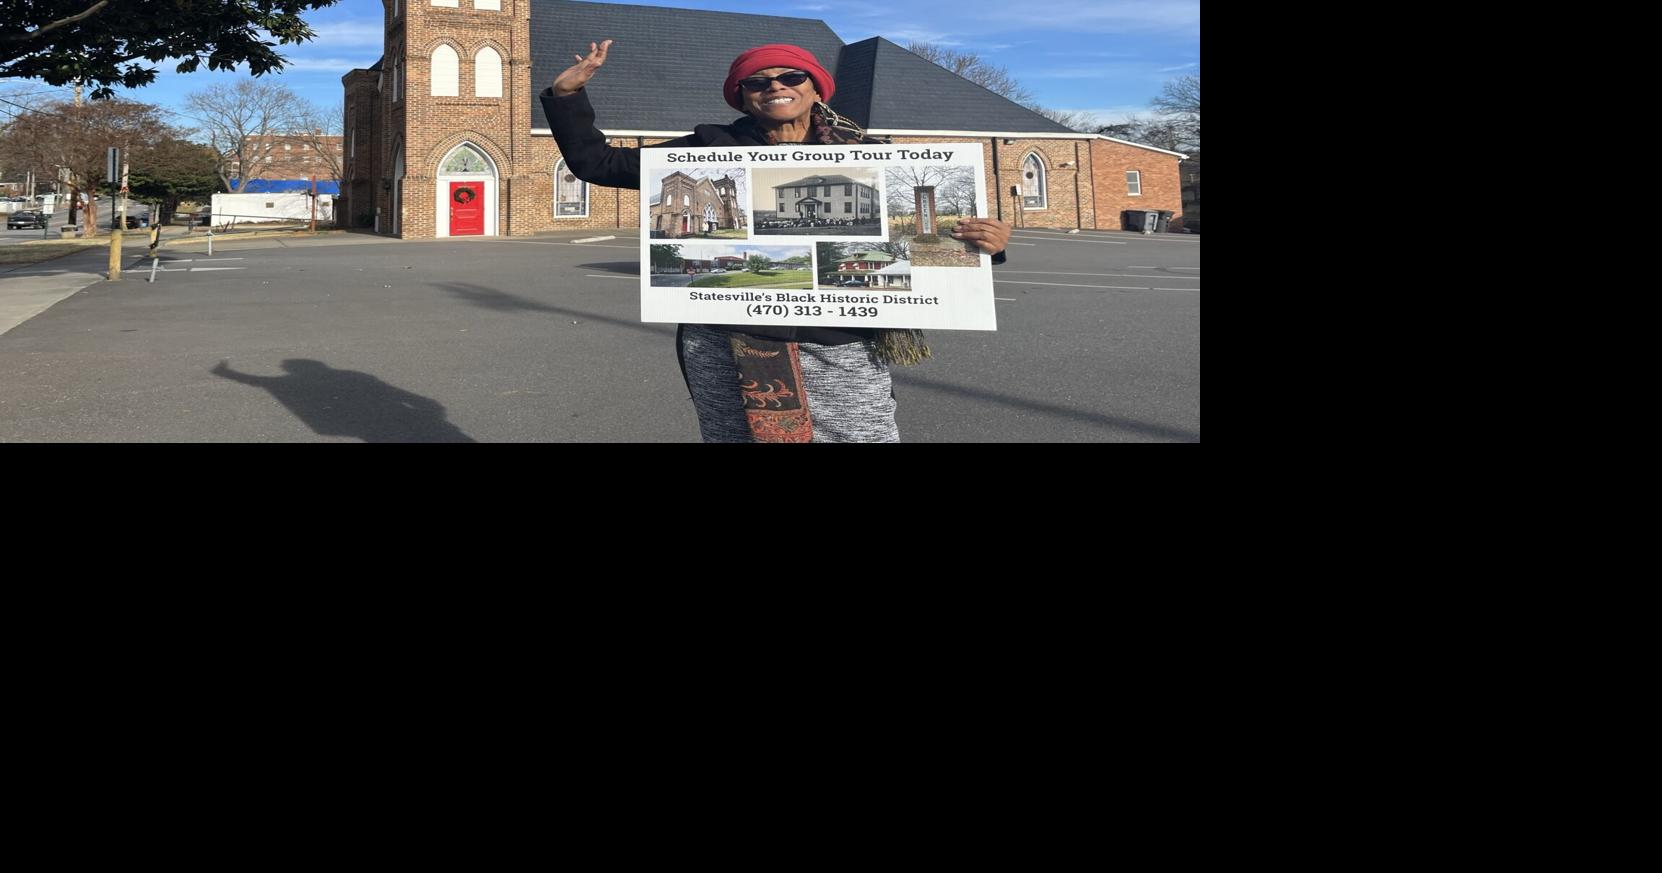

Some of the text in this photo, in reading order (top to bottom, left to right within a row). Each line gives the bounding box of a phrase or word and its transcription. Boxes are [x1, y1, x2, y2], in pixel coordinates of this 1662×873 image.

[667, 149, 954, 164] Schedule Your Group Tour Today
[689, 291, 939, 305] Statesville's Black Historic District
[746, 304, 789, 317] (470)
[794, 306, 822, 316] 313
[839, 307, 878, 317] 1439
